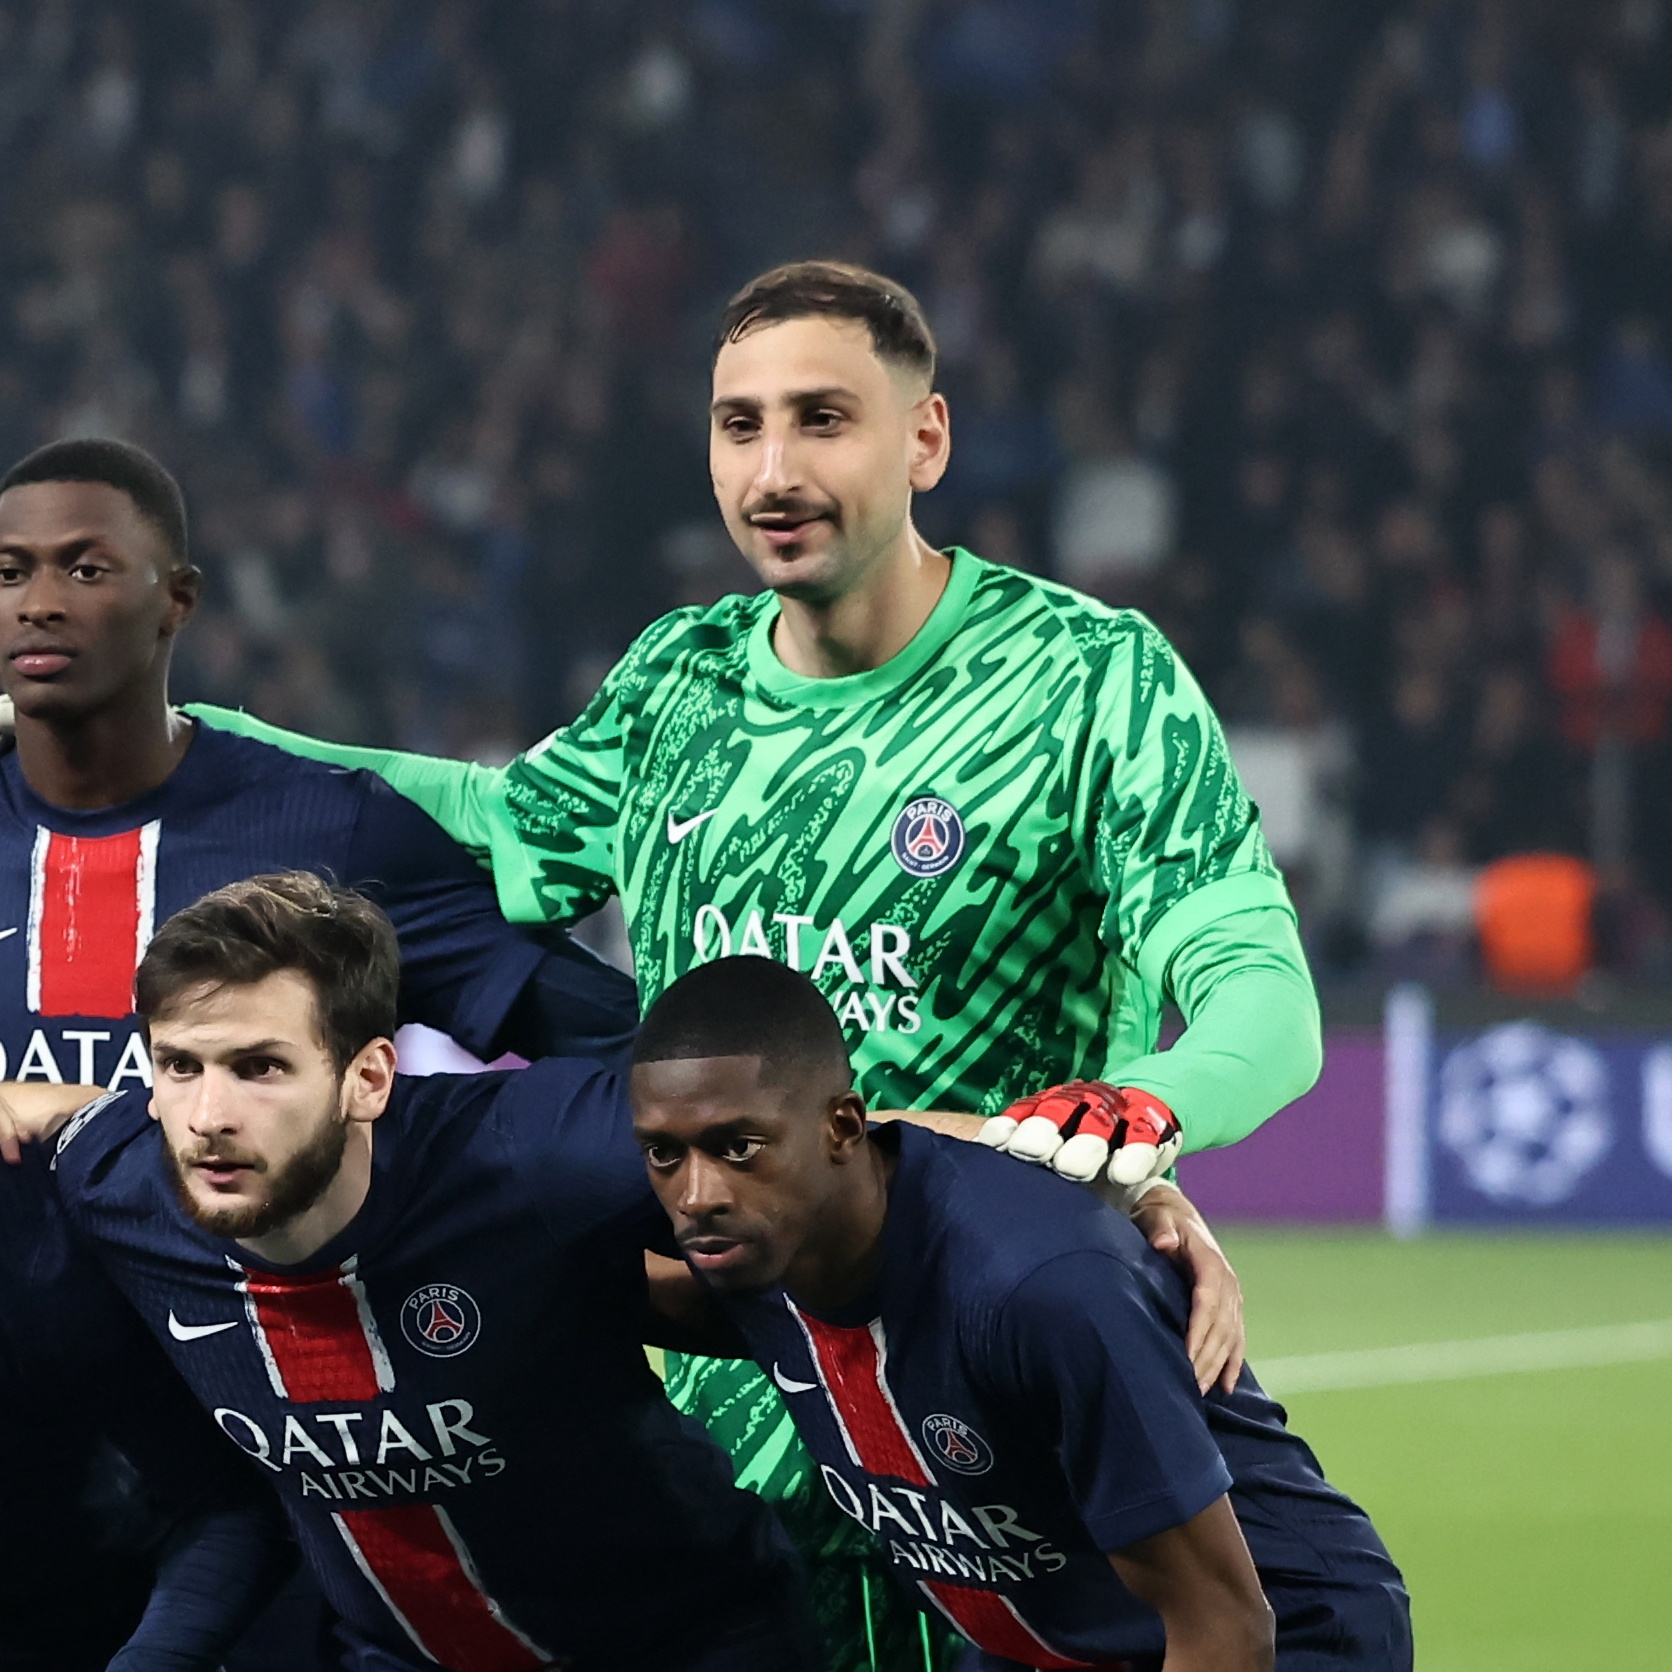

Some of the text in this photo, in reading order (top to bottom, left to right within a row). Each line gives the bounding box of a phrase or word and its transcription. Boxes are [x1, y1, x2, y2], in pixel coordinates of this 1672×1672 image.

[906, 801, 953, 822] PARIS
[408, 1287, 459, 1310] PARIS
[213, 1398, 491, 1472] QATAR
[301, 1448, 506, 1500] AIRWAYS
[820, 1463, 1044, 1547] QATAR
[889, 1542, 1067, 1583] AIRWAYS
